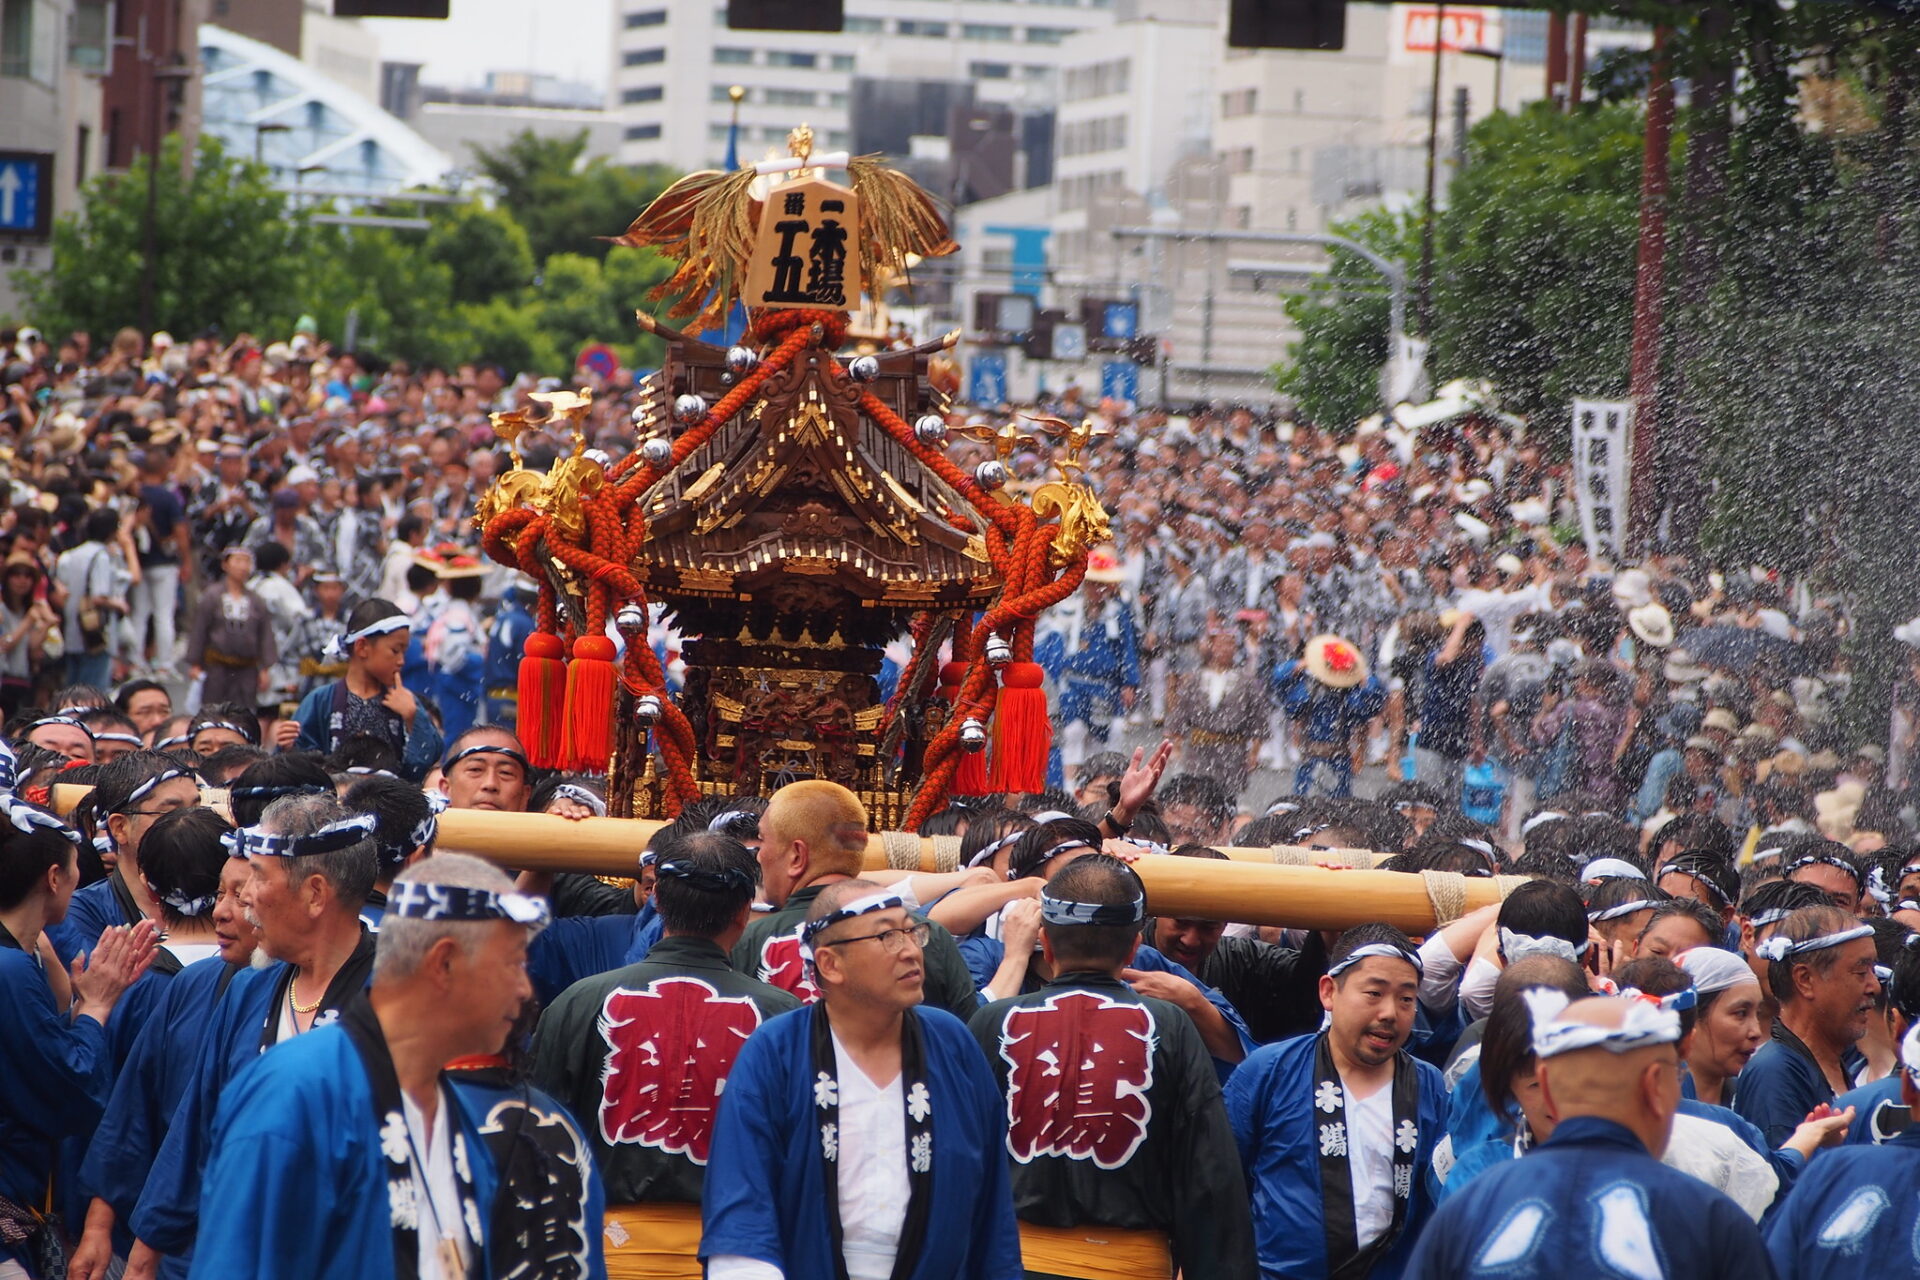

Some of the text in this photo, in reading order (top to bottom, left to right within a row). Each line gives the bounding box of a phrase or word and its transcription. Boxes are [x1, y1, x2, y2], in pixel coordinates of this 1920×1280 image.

[907, 1082, 932, 1173] 木場
[1315, 1081, 1348, 1157] 木場
[1394, 1119, 1419, 1199] 木場
[379, 1111, 418, 1230] 木場
